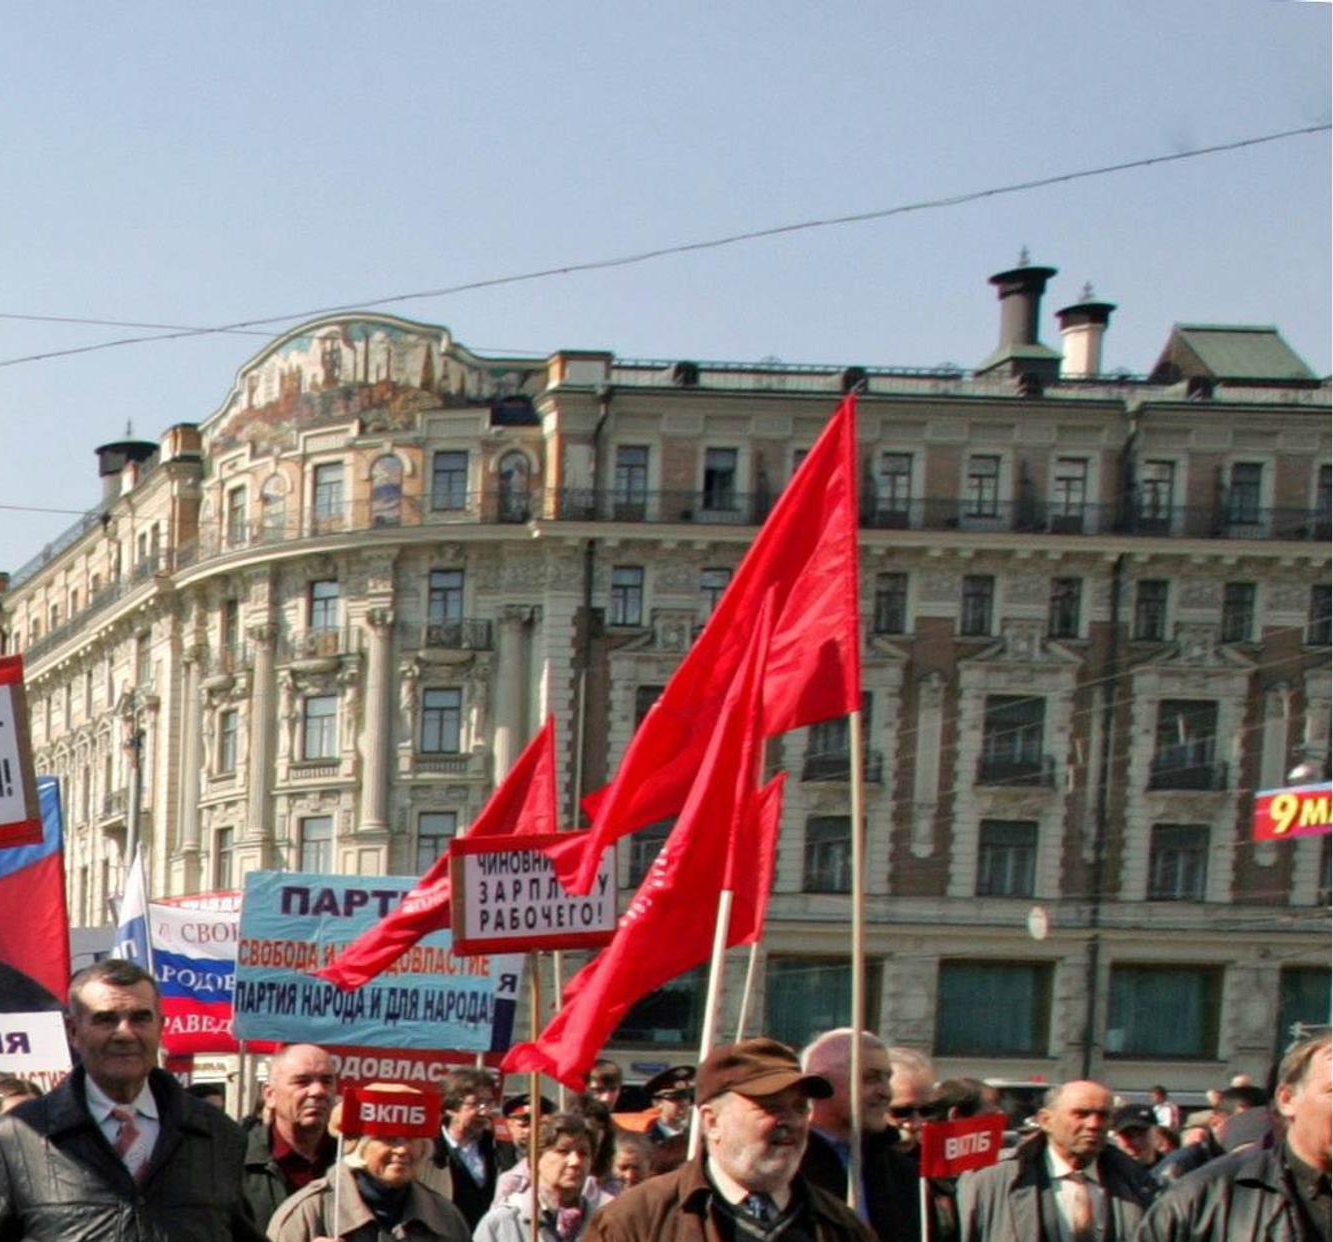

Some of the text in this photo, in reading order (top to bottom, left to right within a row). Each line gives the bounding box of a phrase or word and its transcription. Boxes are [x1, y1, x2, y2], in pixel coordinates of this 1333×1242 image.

[1270, 793, 1333, 834] 9 М
[281, 886, 409, 918] ПАРТ
[479, 873, 609, 904] ЗАРПЛУ
[480, 902, 604, 932] РАБОЧЕГО!
[238, 939, 318, 972] СВОБОДА
[234, 980, 297, 1014] ПАРТИЯ
[301, 983, 365, 1024] НАРОДА
[371, 986, 382, 1018] И
[385, 987, 419, 1026] ДЛЯ
[359, 1102, 426, 1125] ВКПБ
